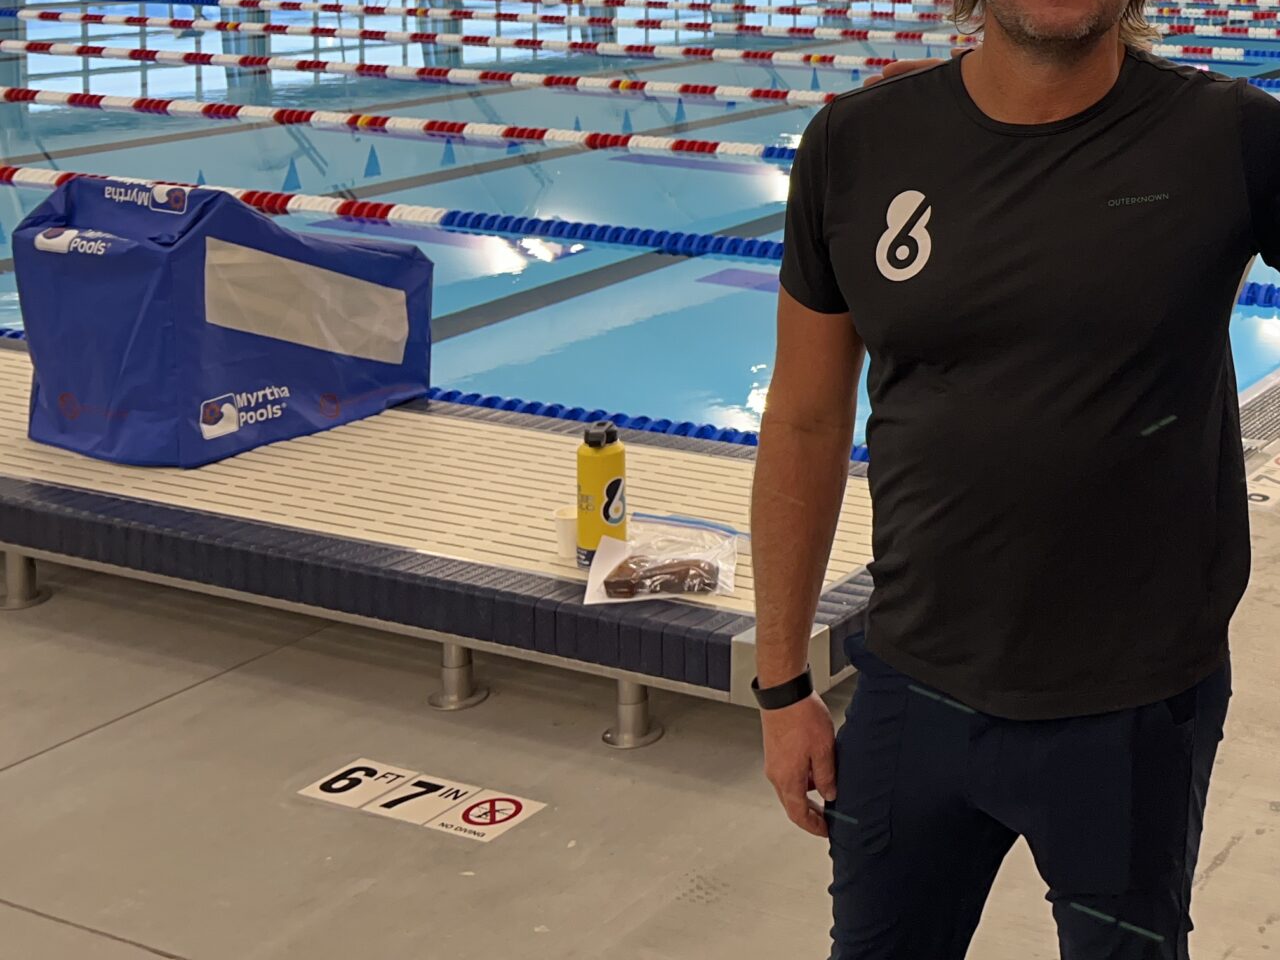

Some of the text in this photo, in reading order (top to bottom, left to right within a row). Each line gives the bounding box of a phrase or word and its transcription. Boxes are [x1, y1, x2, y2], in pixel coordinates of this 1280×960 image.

[104, 186, 151, 206] Myrtha
[236, 385, 289, 409] Myrtha
[318, 766, 469, 809] 6 FT 7 IN
